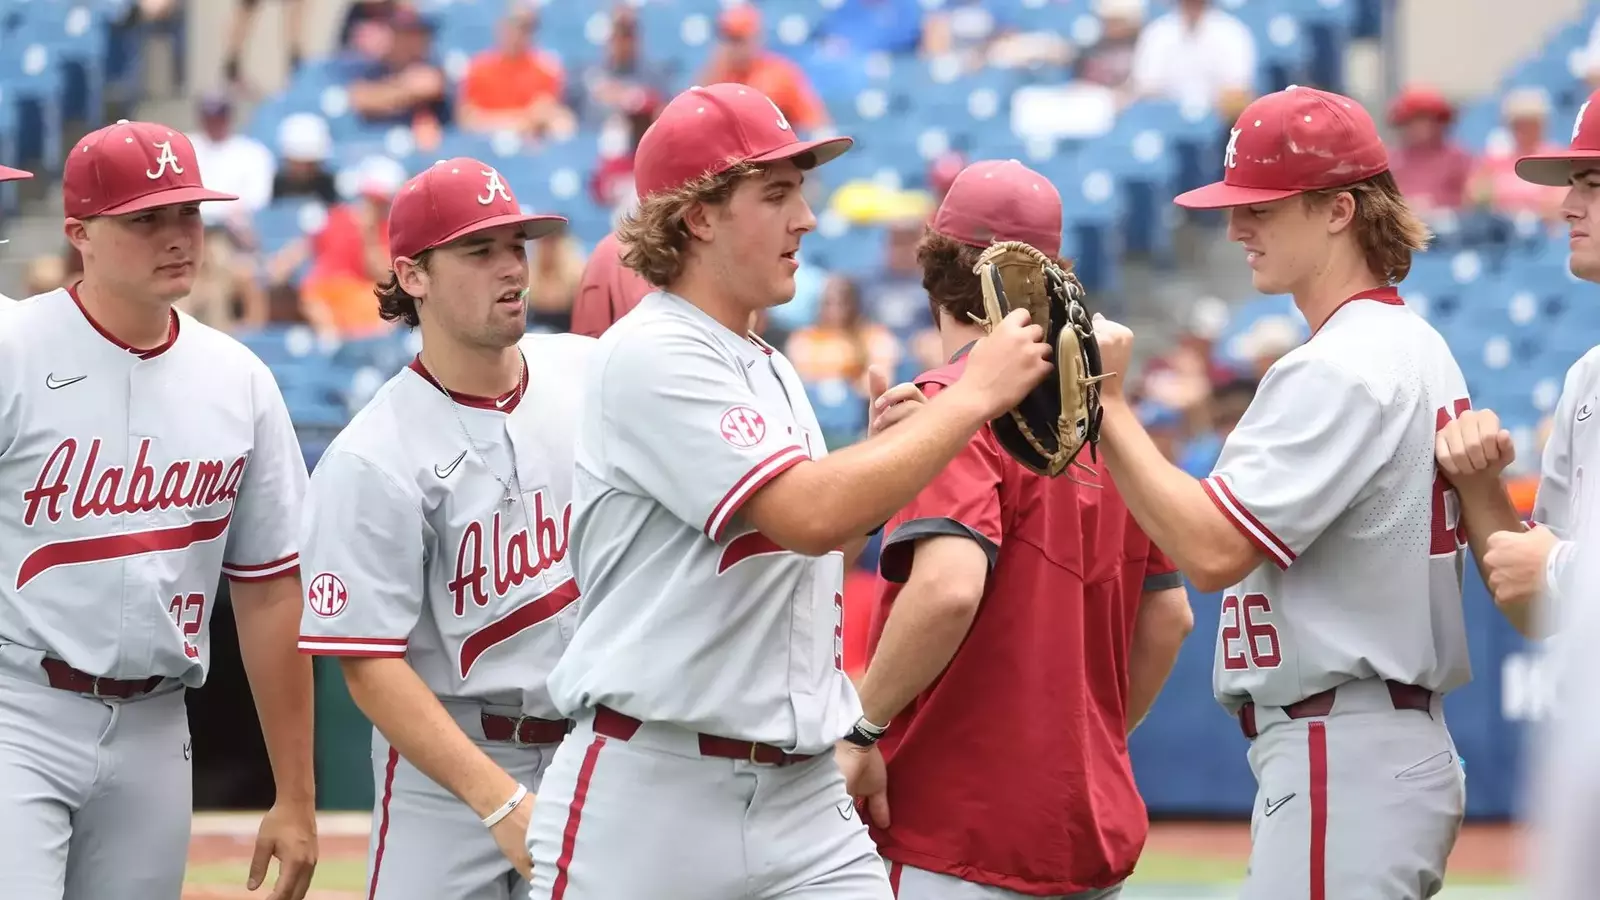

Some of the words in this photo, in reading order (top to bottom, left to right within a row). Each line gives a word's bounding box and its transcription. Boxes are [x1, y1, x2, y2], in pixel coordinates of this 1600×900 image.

[146, 140, 184, 179] A
[477, 167, 512, 205] A
[720, 406, 766, 448] SEC
[22, 436, 248, 526] Alabama
[309, 573, 348, 616] SEC
[1221, 592, 1283, 671] 26
